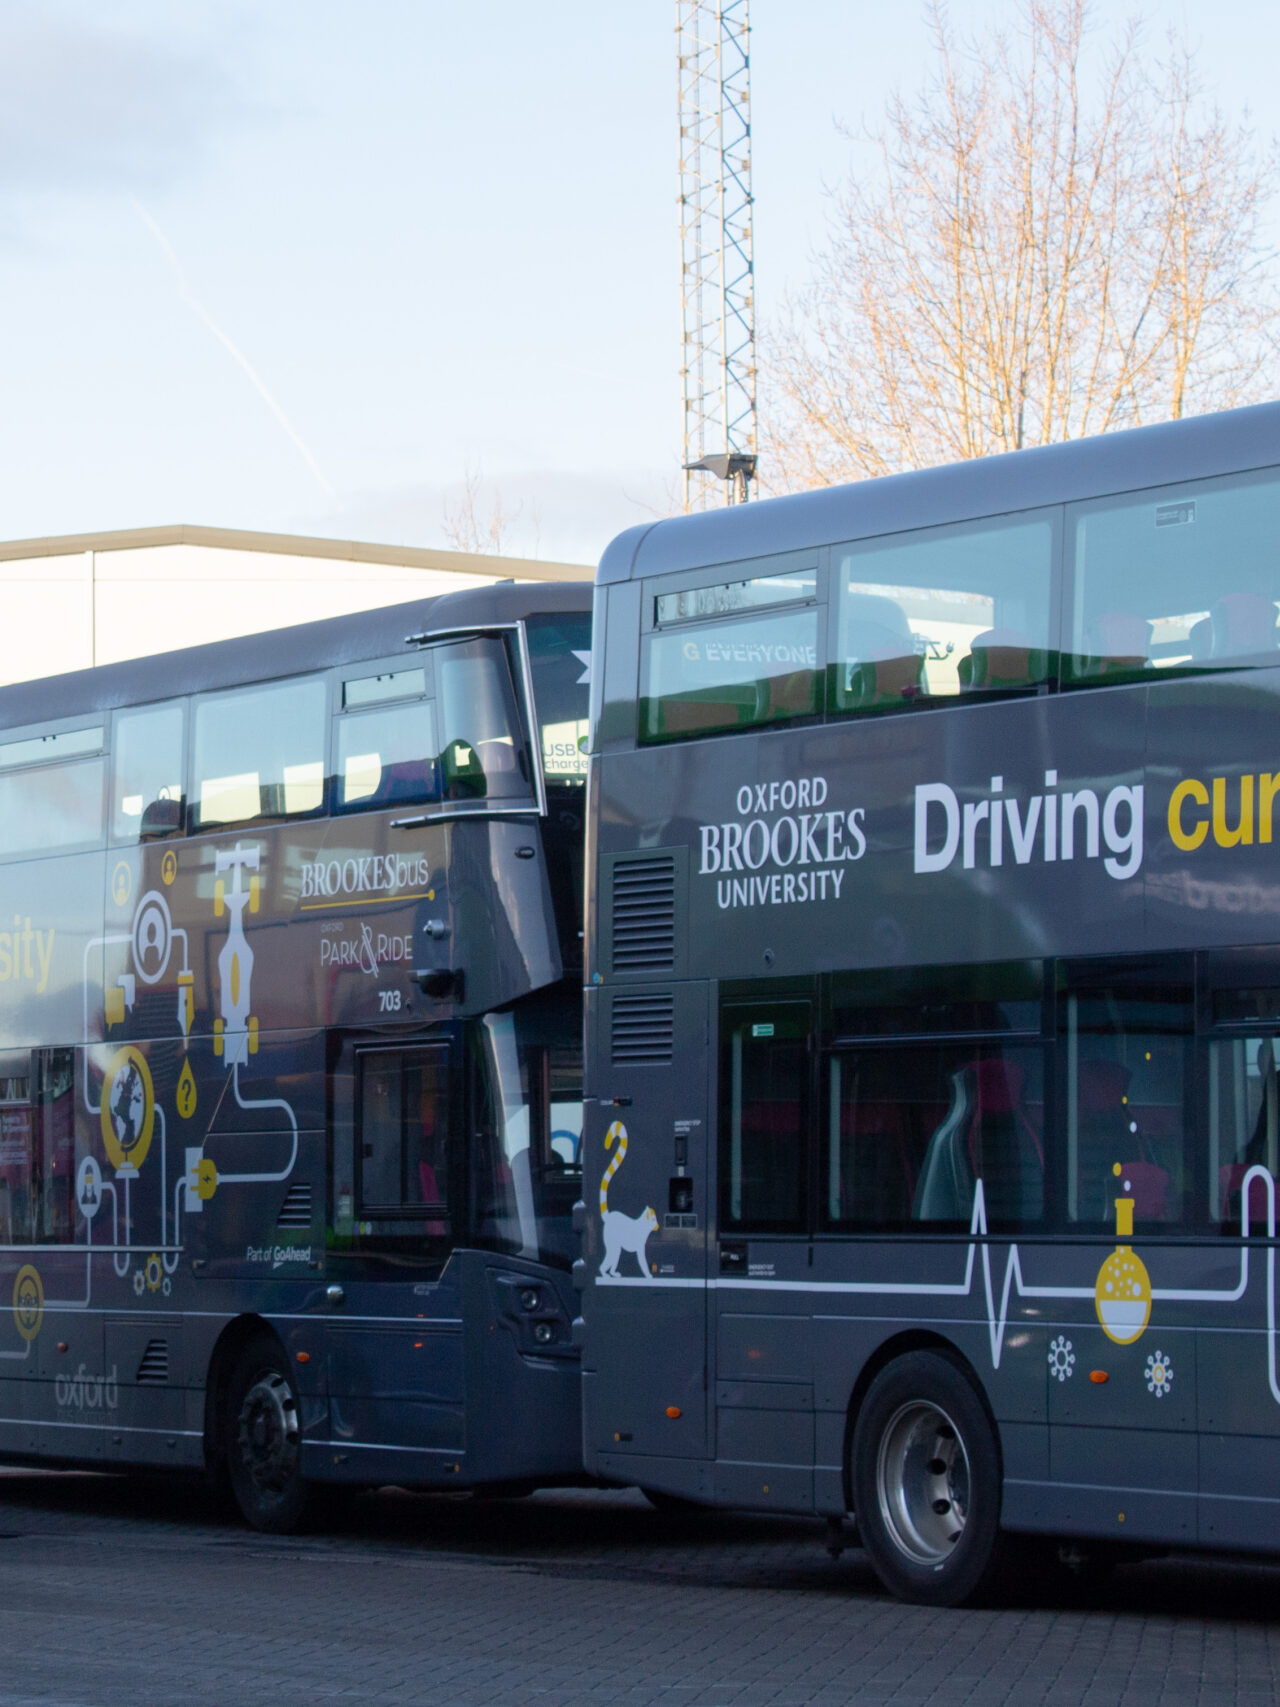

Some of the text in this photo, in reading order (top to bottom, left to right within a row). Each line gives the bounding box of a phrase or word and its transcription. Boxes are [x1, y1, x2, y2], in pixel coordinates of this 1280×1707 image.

[705, 641, 817, 664] EVERYONE
[542, 743, 576, 757] USB
[736, 777, 828, 815] OXFORD
[698, 808, 867, 874] BROOKES
[914, 769, 1144, 880] Driving
[717, 869, 845, 909] UNIVERSITY
[378, 990, 401, 1012] 703
[247, 1246, 262, 1261] Part
[264, 1246, 272, 1261] of
[55, 1363, 119, 1411] oxford
